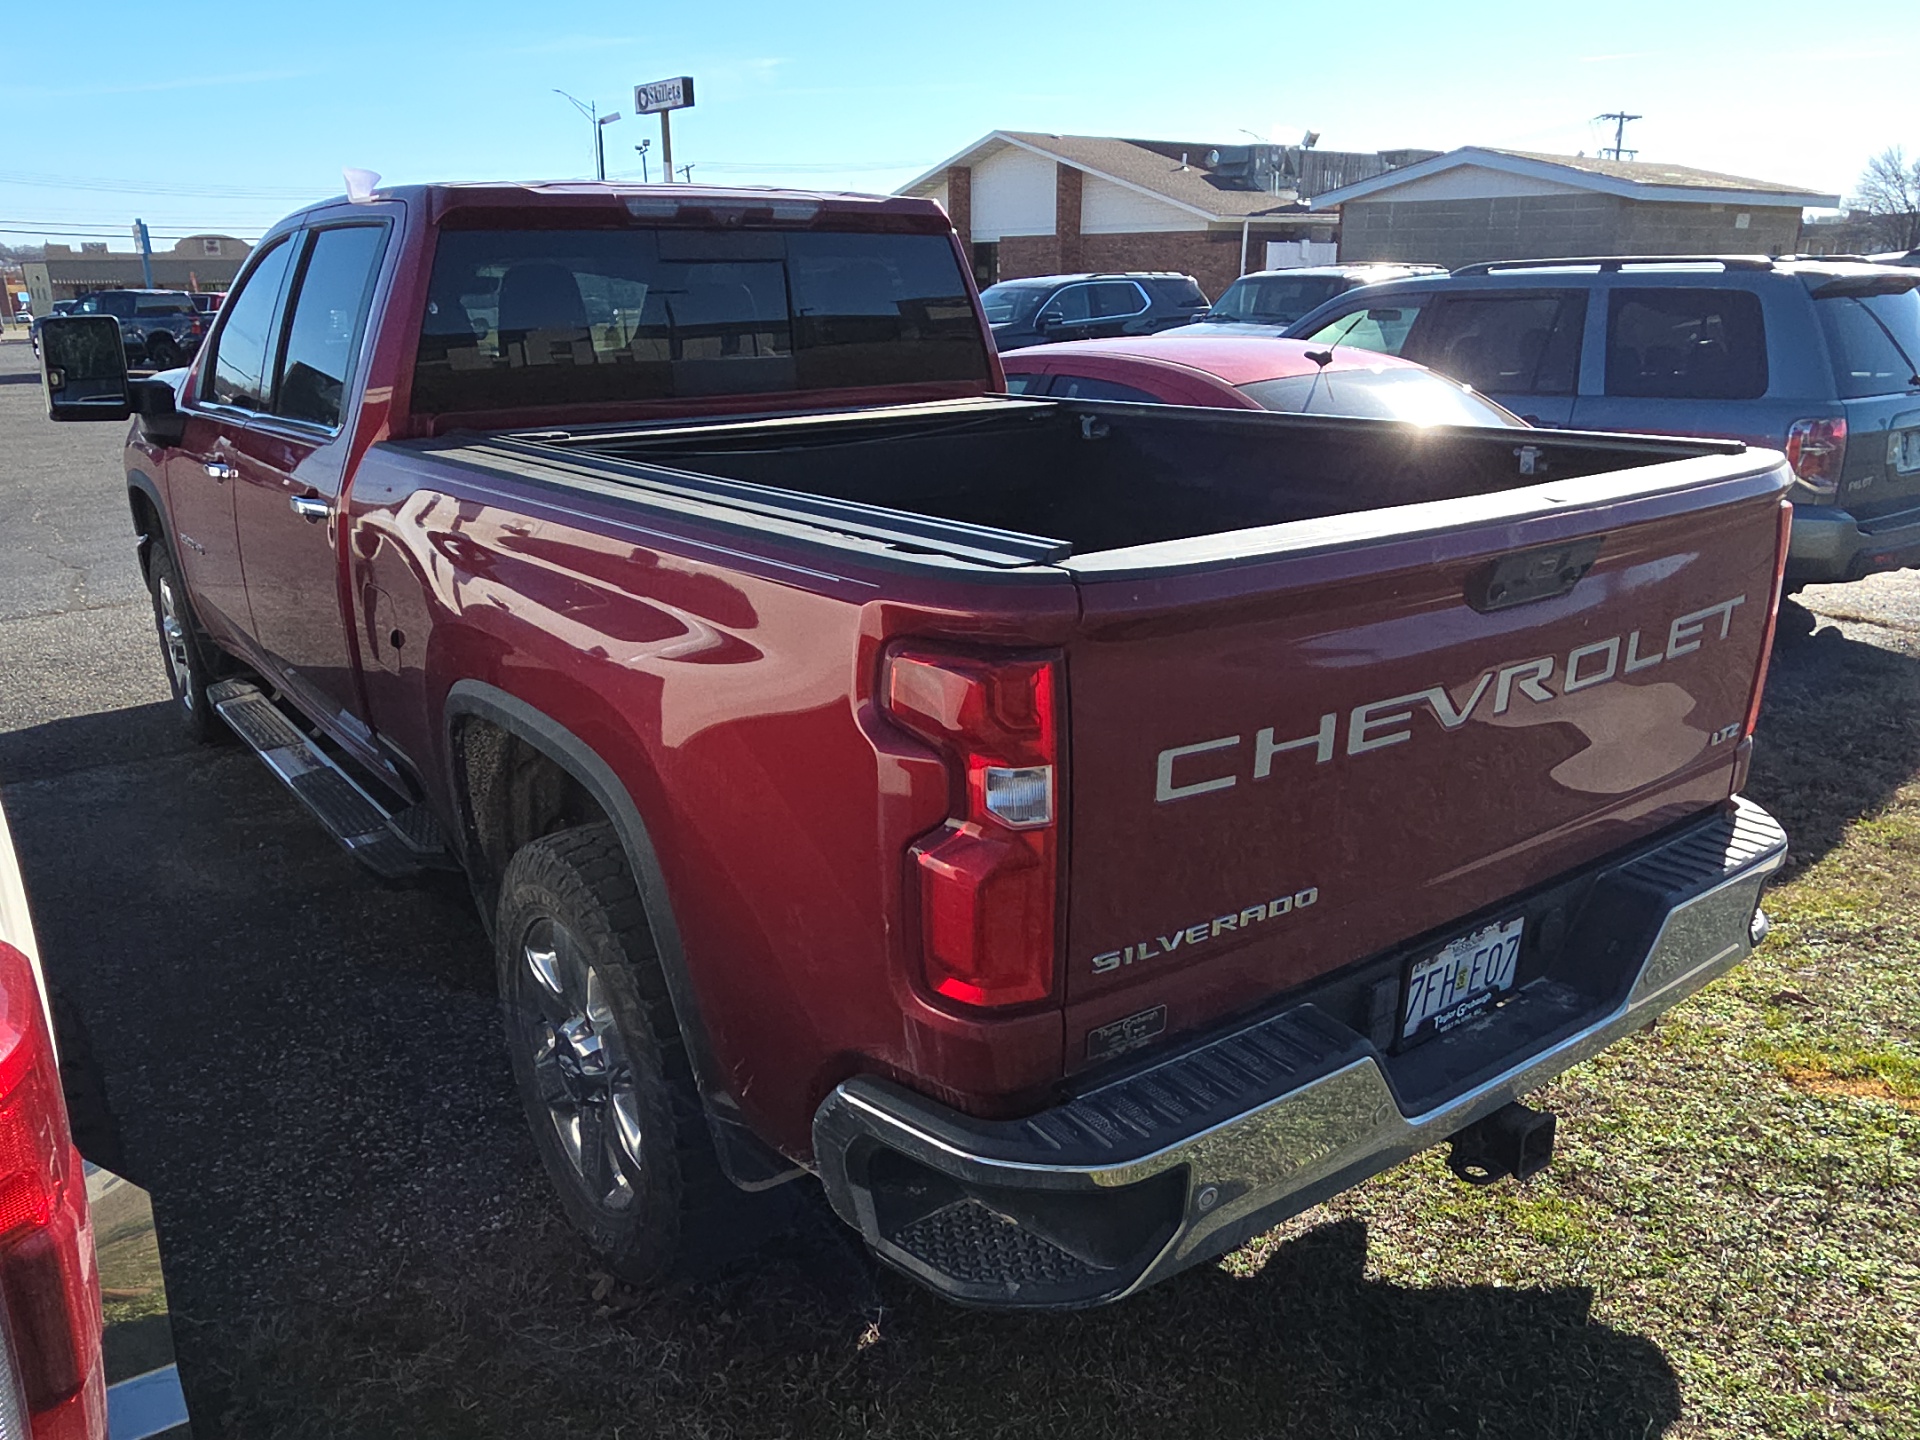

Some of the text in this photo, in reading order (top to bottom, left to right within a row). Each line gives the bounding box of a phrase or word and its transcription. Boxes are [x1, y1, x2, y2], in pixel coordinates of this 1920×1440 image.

[1155, 594, 1746, 802] CHEVROLET
[1711, 722, 1741, 747] LTZ
[1092, 887, 1319, 975] SILVERADO
[1405, 959, 1461, 1025] 7FH
